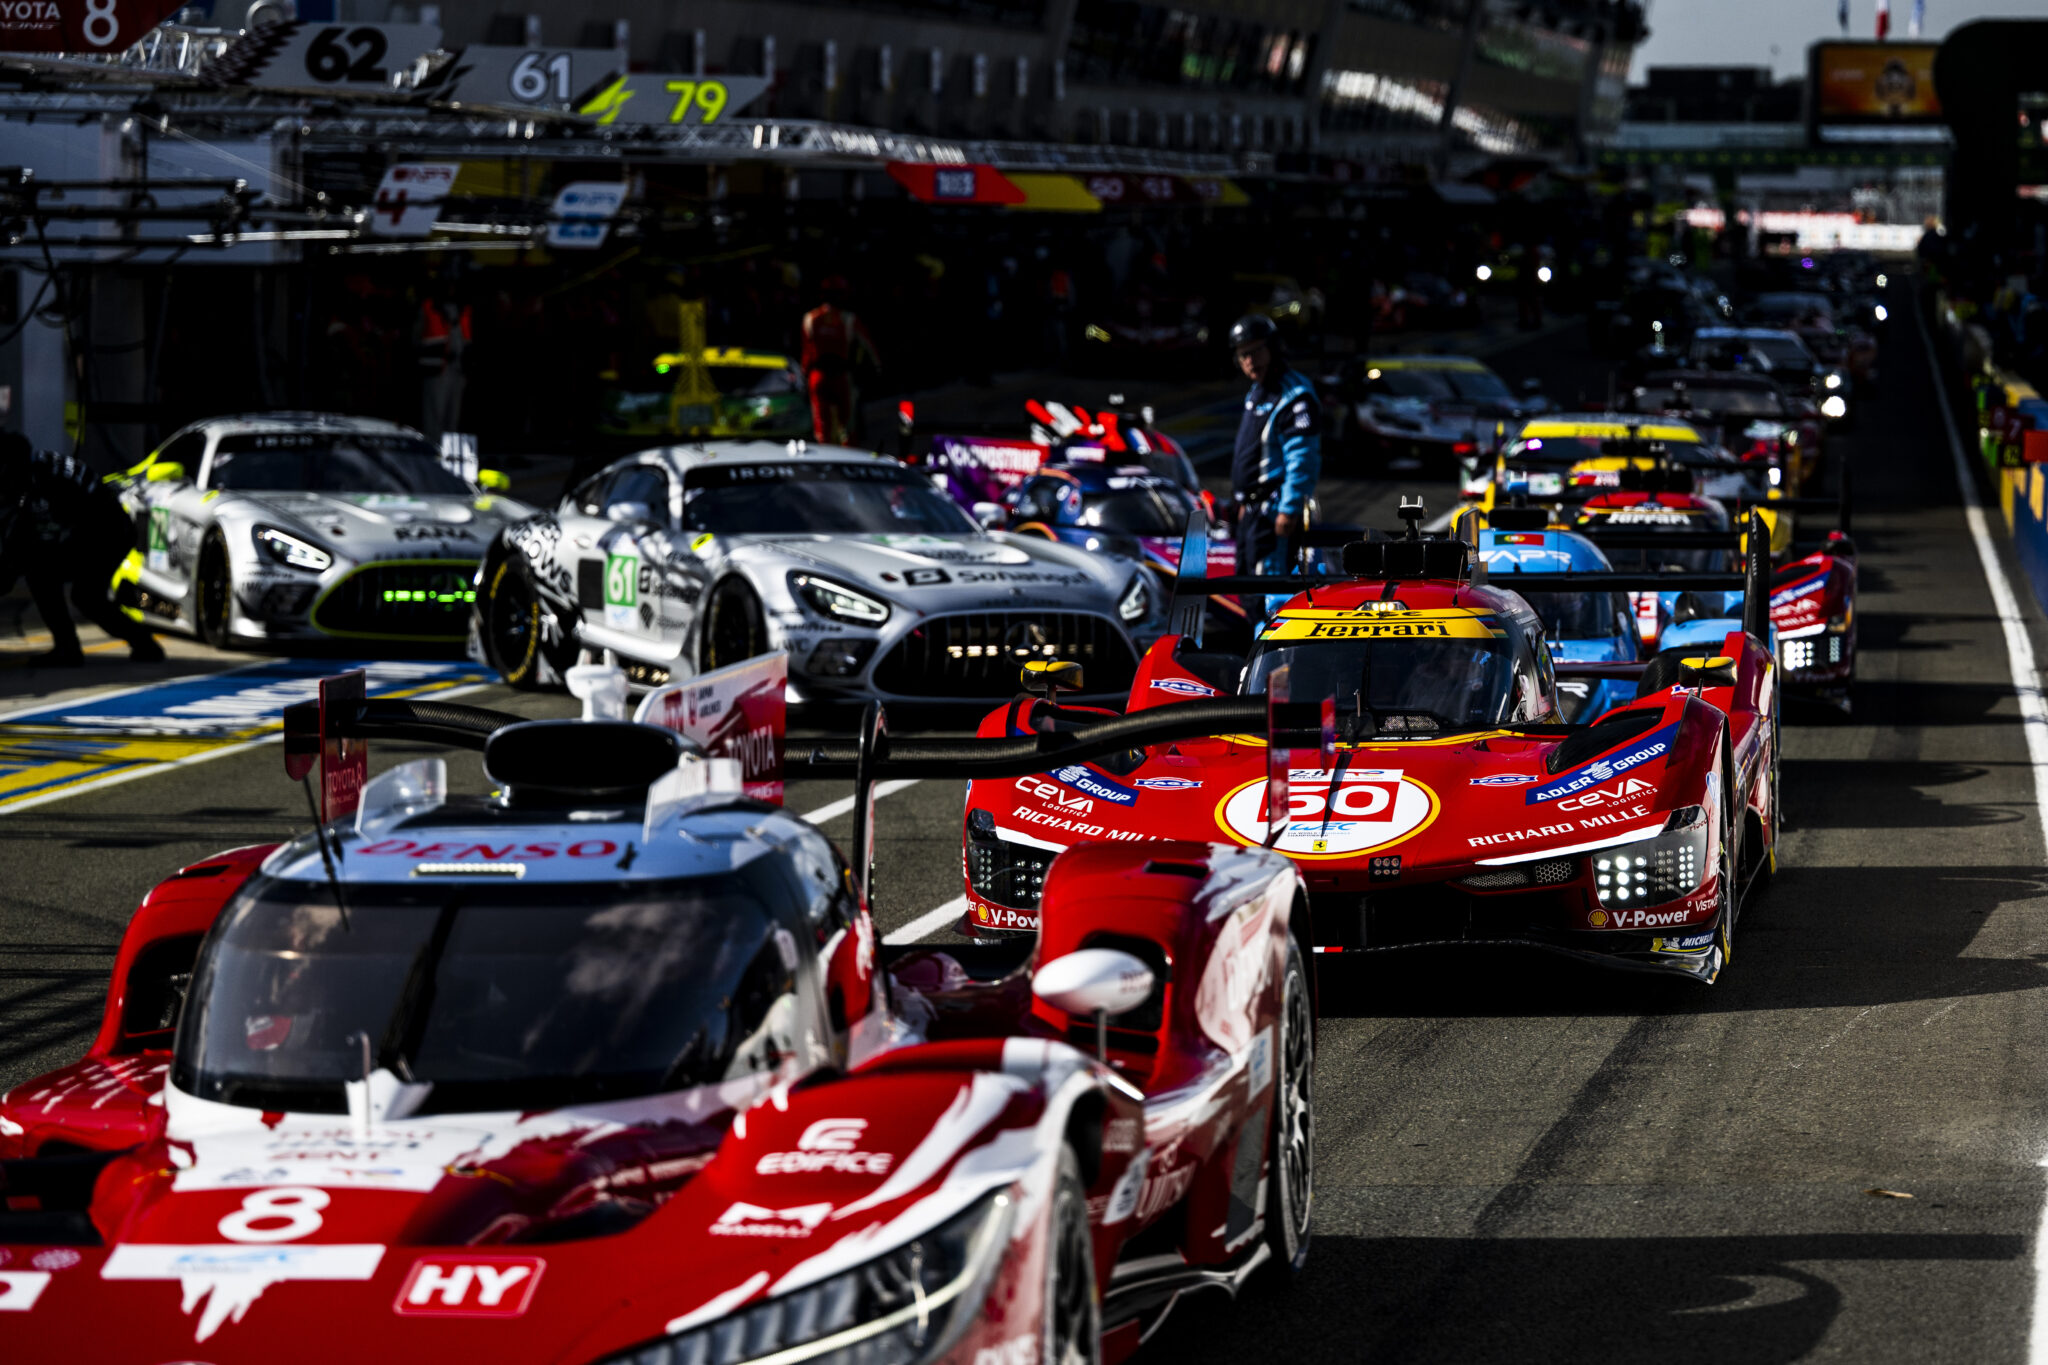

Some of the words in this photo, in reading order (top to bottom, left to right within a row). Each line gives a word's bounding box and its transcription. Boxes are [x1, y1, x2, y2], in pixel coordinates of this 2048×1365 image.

[0, 1, 61, 19] YOTA
[82, 0, 120, 47] 8
[307, 28, 387, 82] 62
[510, 51, 573, 101] 61
[665, 80, 728, 124] 79
[377, 189, 408, 225] 4
[729, 465, 795, 481] IRON
[609, 557, 634, 604] 61
[1305, 620, 1451, 638] Ferrari
[327, 768, 355, 792] TOYOTA
[1536, 776, 1596, 802] ADLER
[1615, 742, 1667, 771] GROUP
[1076, 778, 1131, 801] GROUP
[1266, 784, 1390, 816] 50
[1606, 787, 1658, 808] LOGISTICS
[1012, 806, 1104, 837] RICHARD
[1467, 822, 1575, 848] RICHARD
[1580, 804, 1650, 829] MILLE
[355, 839, 618, 860] DENSO
[990, 908, 1041, 929] V-Pow
[1612, 909, 1690, 928] V-Power
[755, 1151, 894, 1175] EDIFICE
[217, 1186, 332, 1244] 8
[407, 1264, 531, 1307] HY
